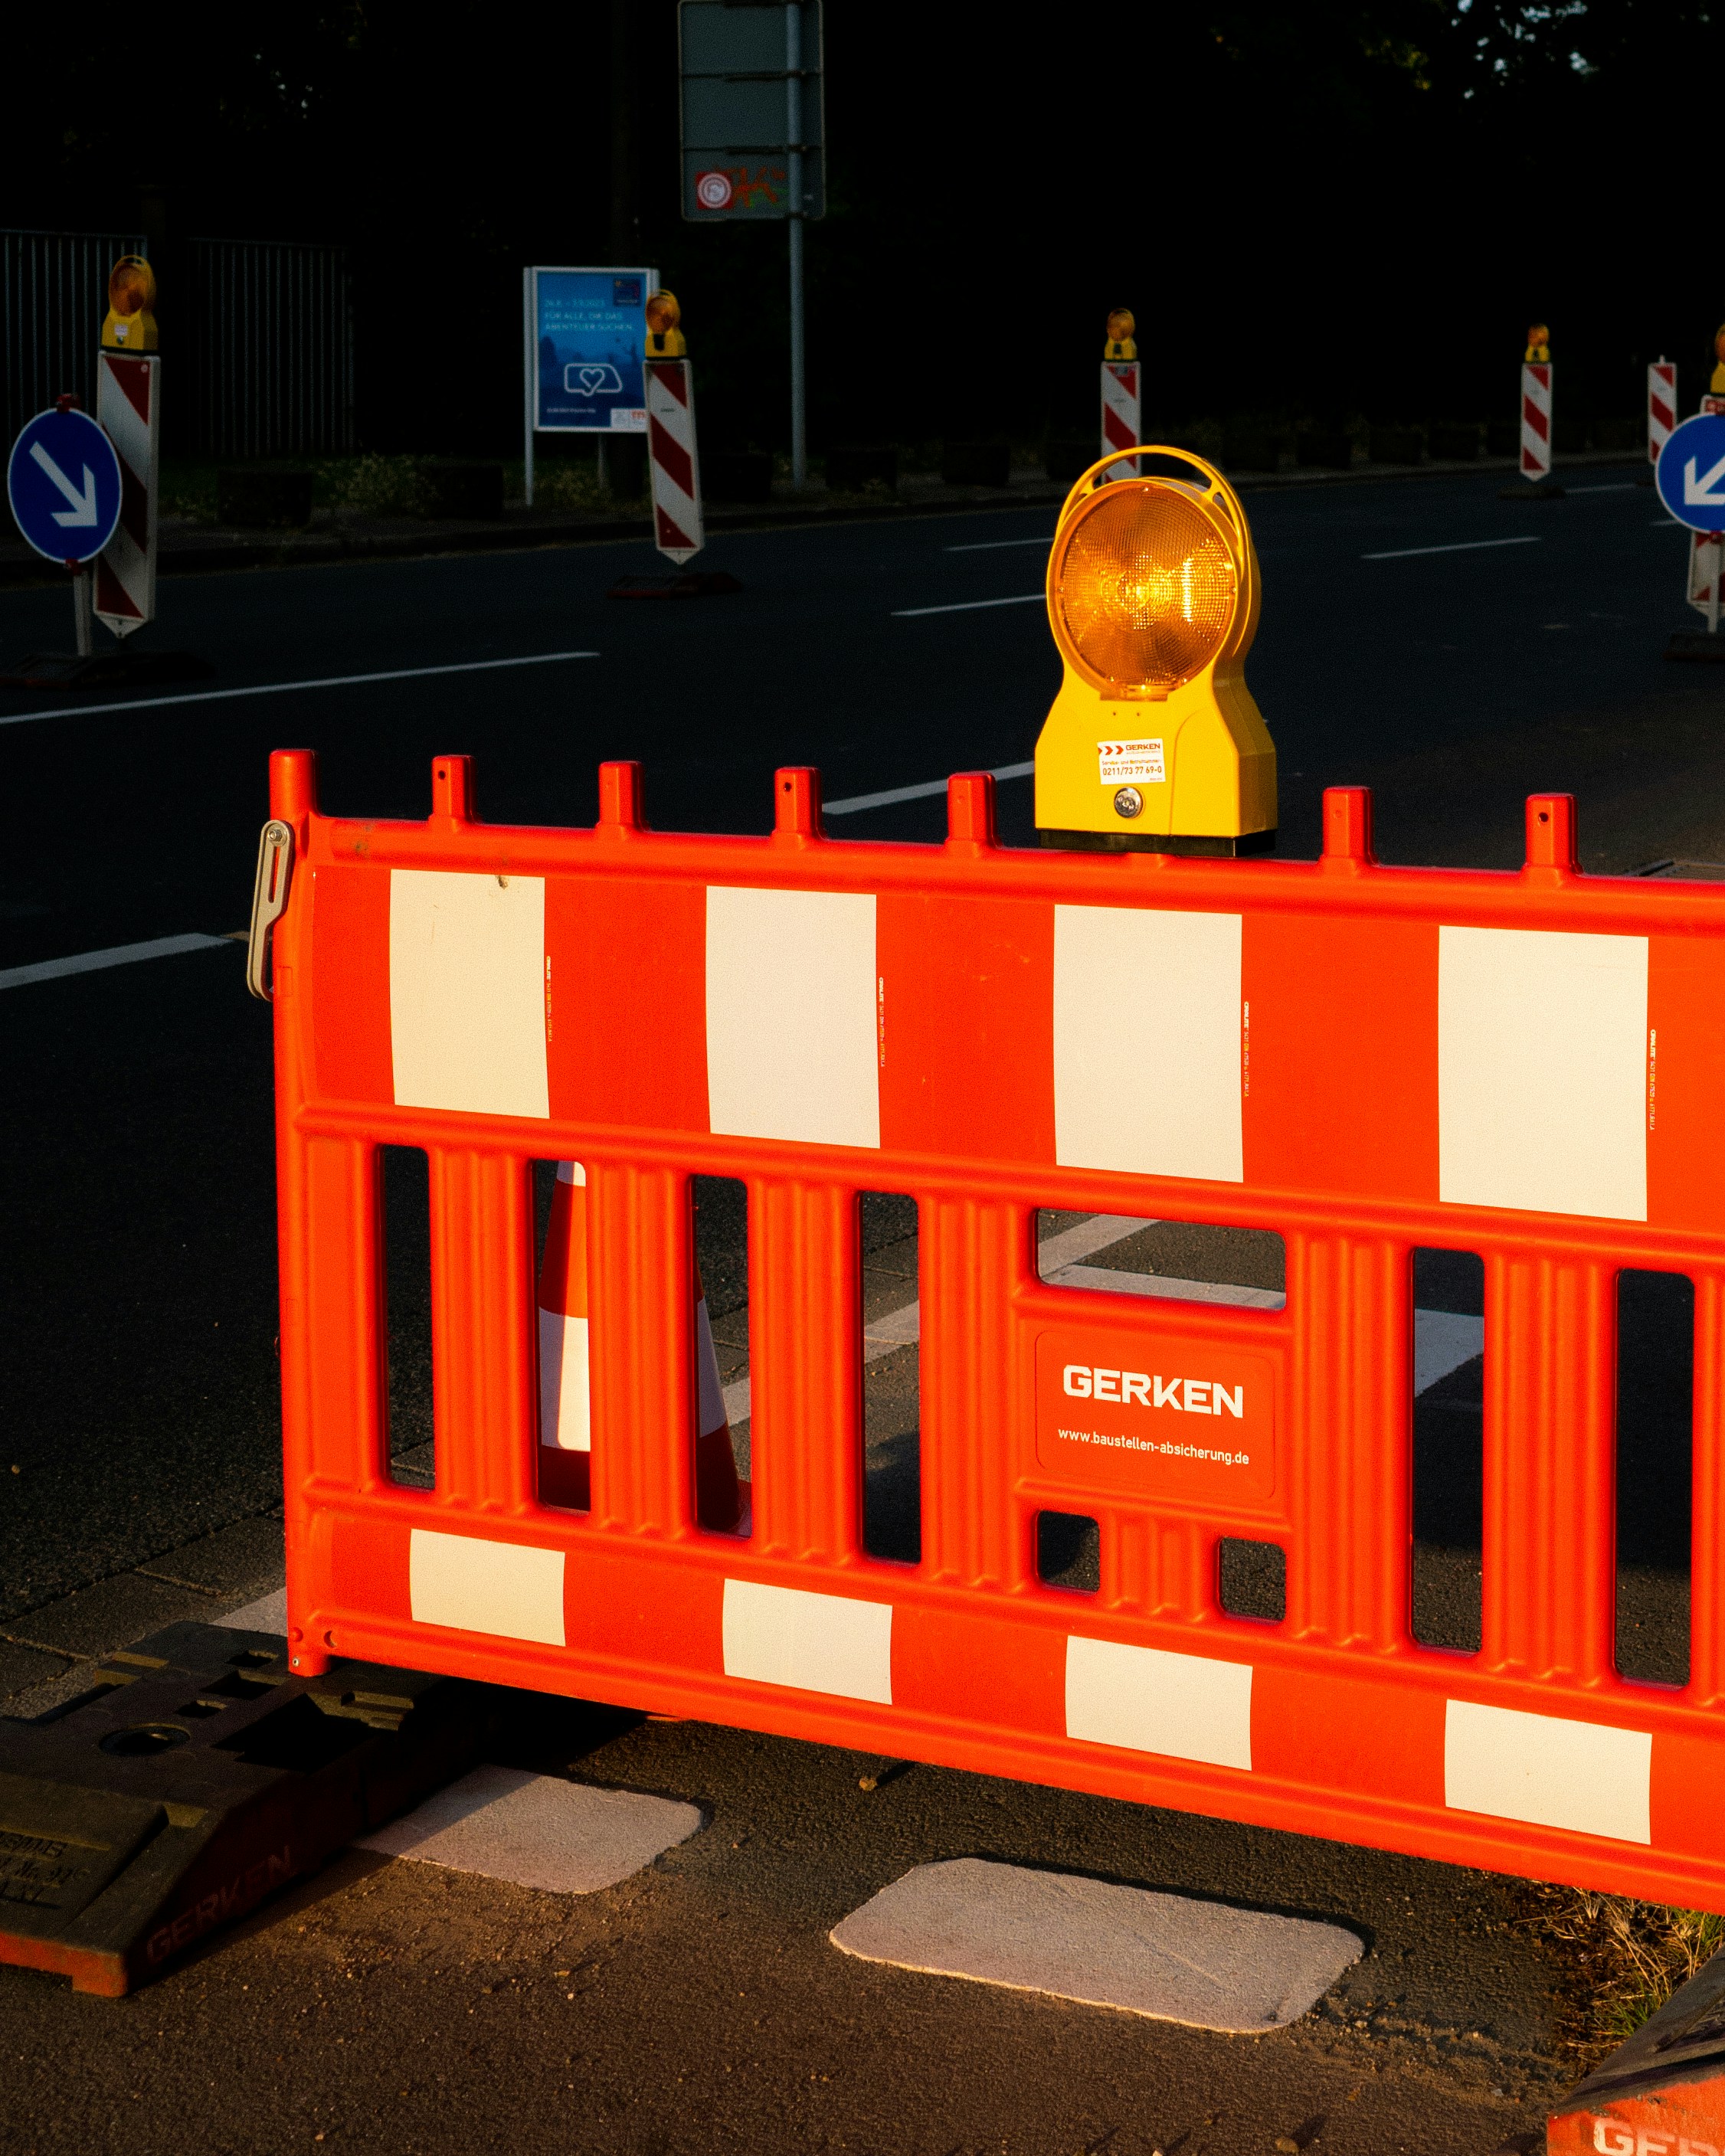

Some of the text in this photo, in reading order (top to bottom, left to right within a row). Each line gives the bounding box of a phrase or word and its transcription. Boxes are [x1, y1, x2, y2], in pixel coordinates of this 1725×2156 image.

[1103, 767, 1133, 775] 0211/73
[1063, 1364, 1243, 1418] GERKEN
[1058, 1428, 1249, 1465] www.baustellen-absicherung.de
[146, 1845, 293, 1965] GERKEN
